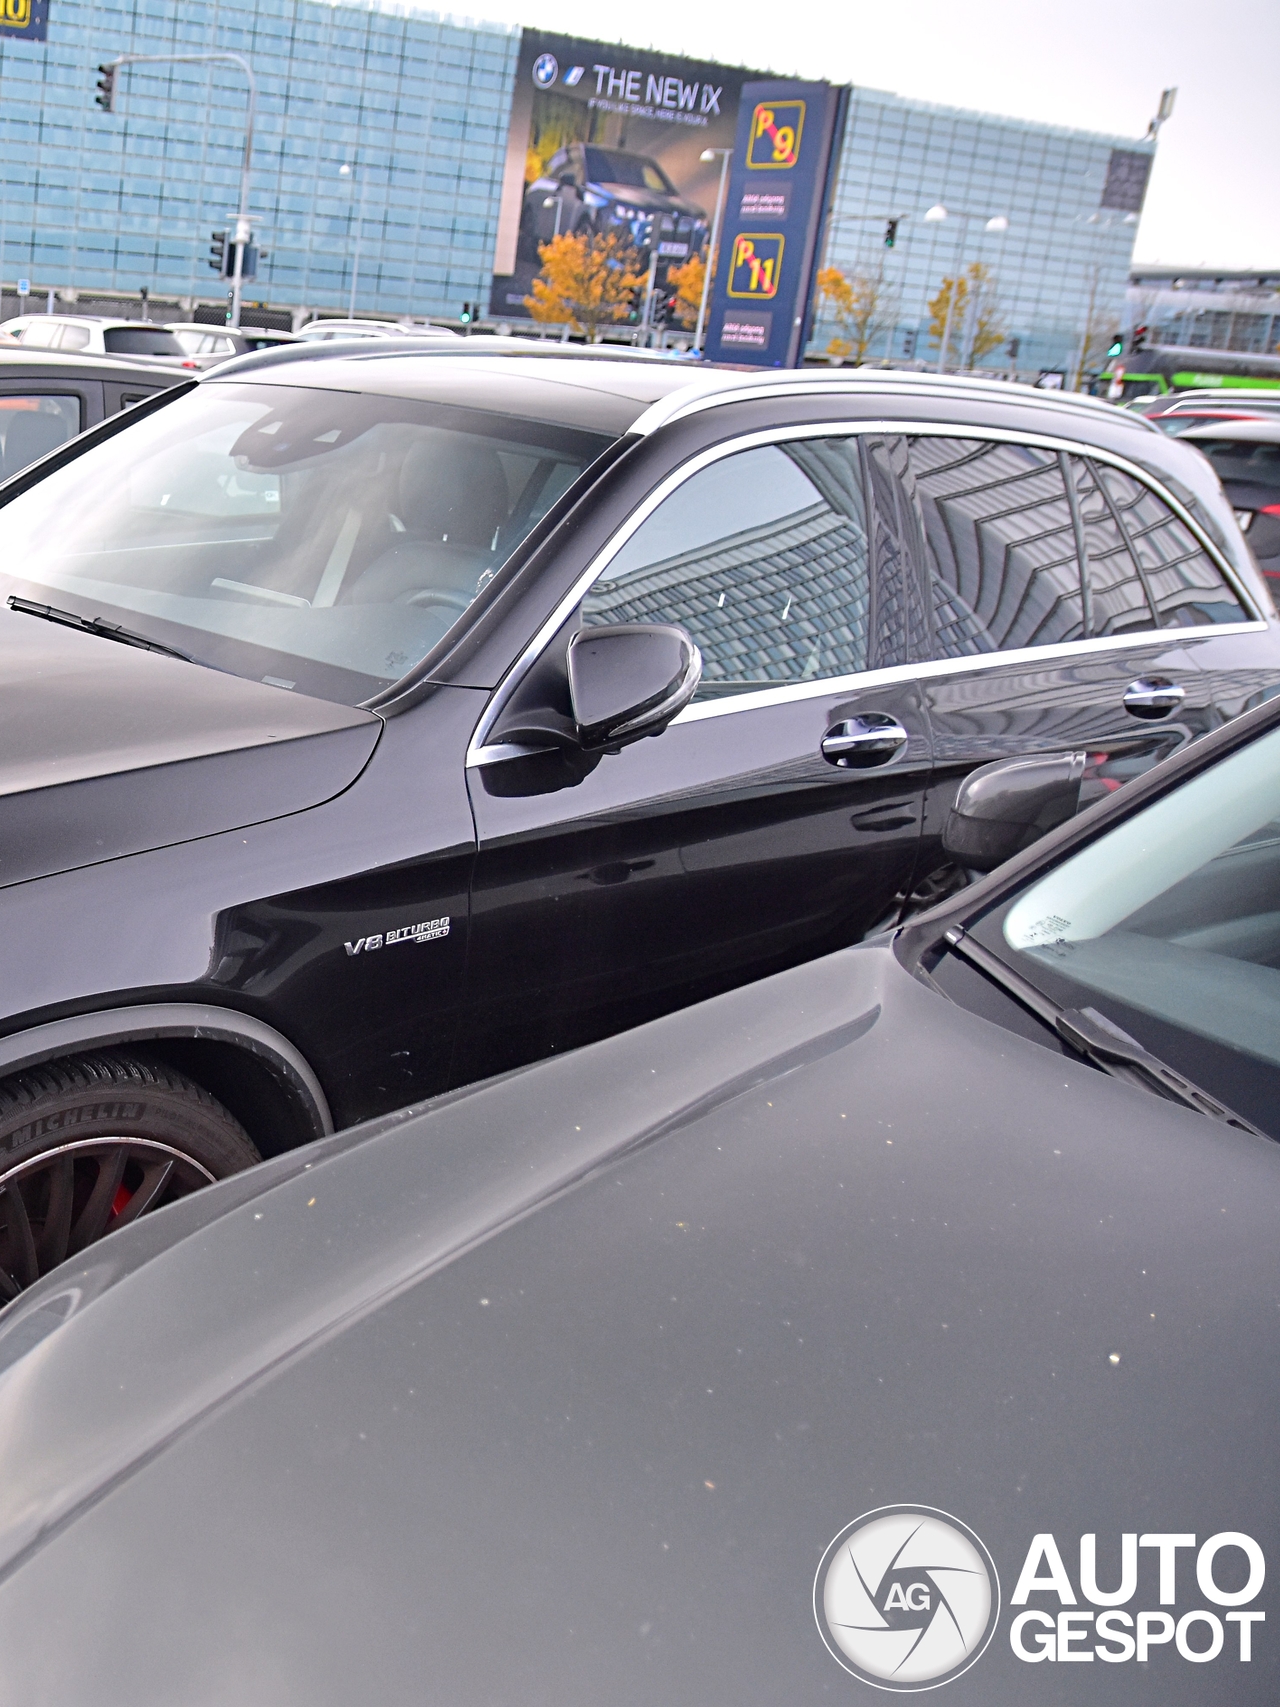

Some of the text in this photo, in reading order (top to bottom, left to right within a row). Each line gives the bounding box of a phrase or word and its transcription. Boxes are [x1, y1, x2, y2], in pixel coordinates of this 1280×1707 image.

[593, 64, 642, 102] THE
[645, 73, 700, 111] NEW
[756, 110, 775, 138] P
[772, 126, 795, 161] 9
[736, 241, 755, 268] P
[749, 258, 775, 291] 11
[344, 916, 450, 956] V8 BITURBO
[12, 1102, 137, 1147] MICHELIN
